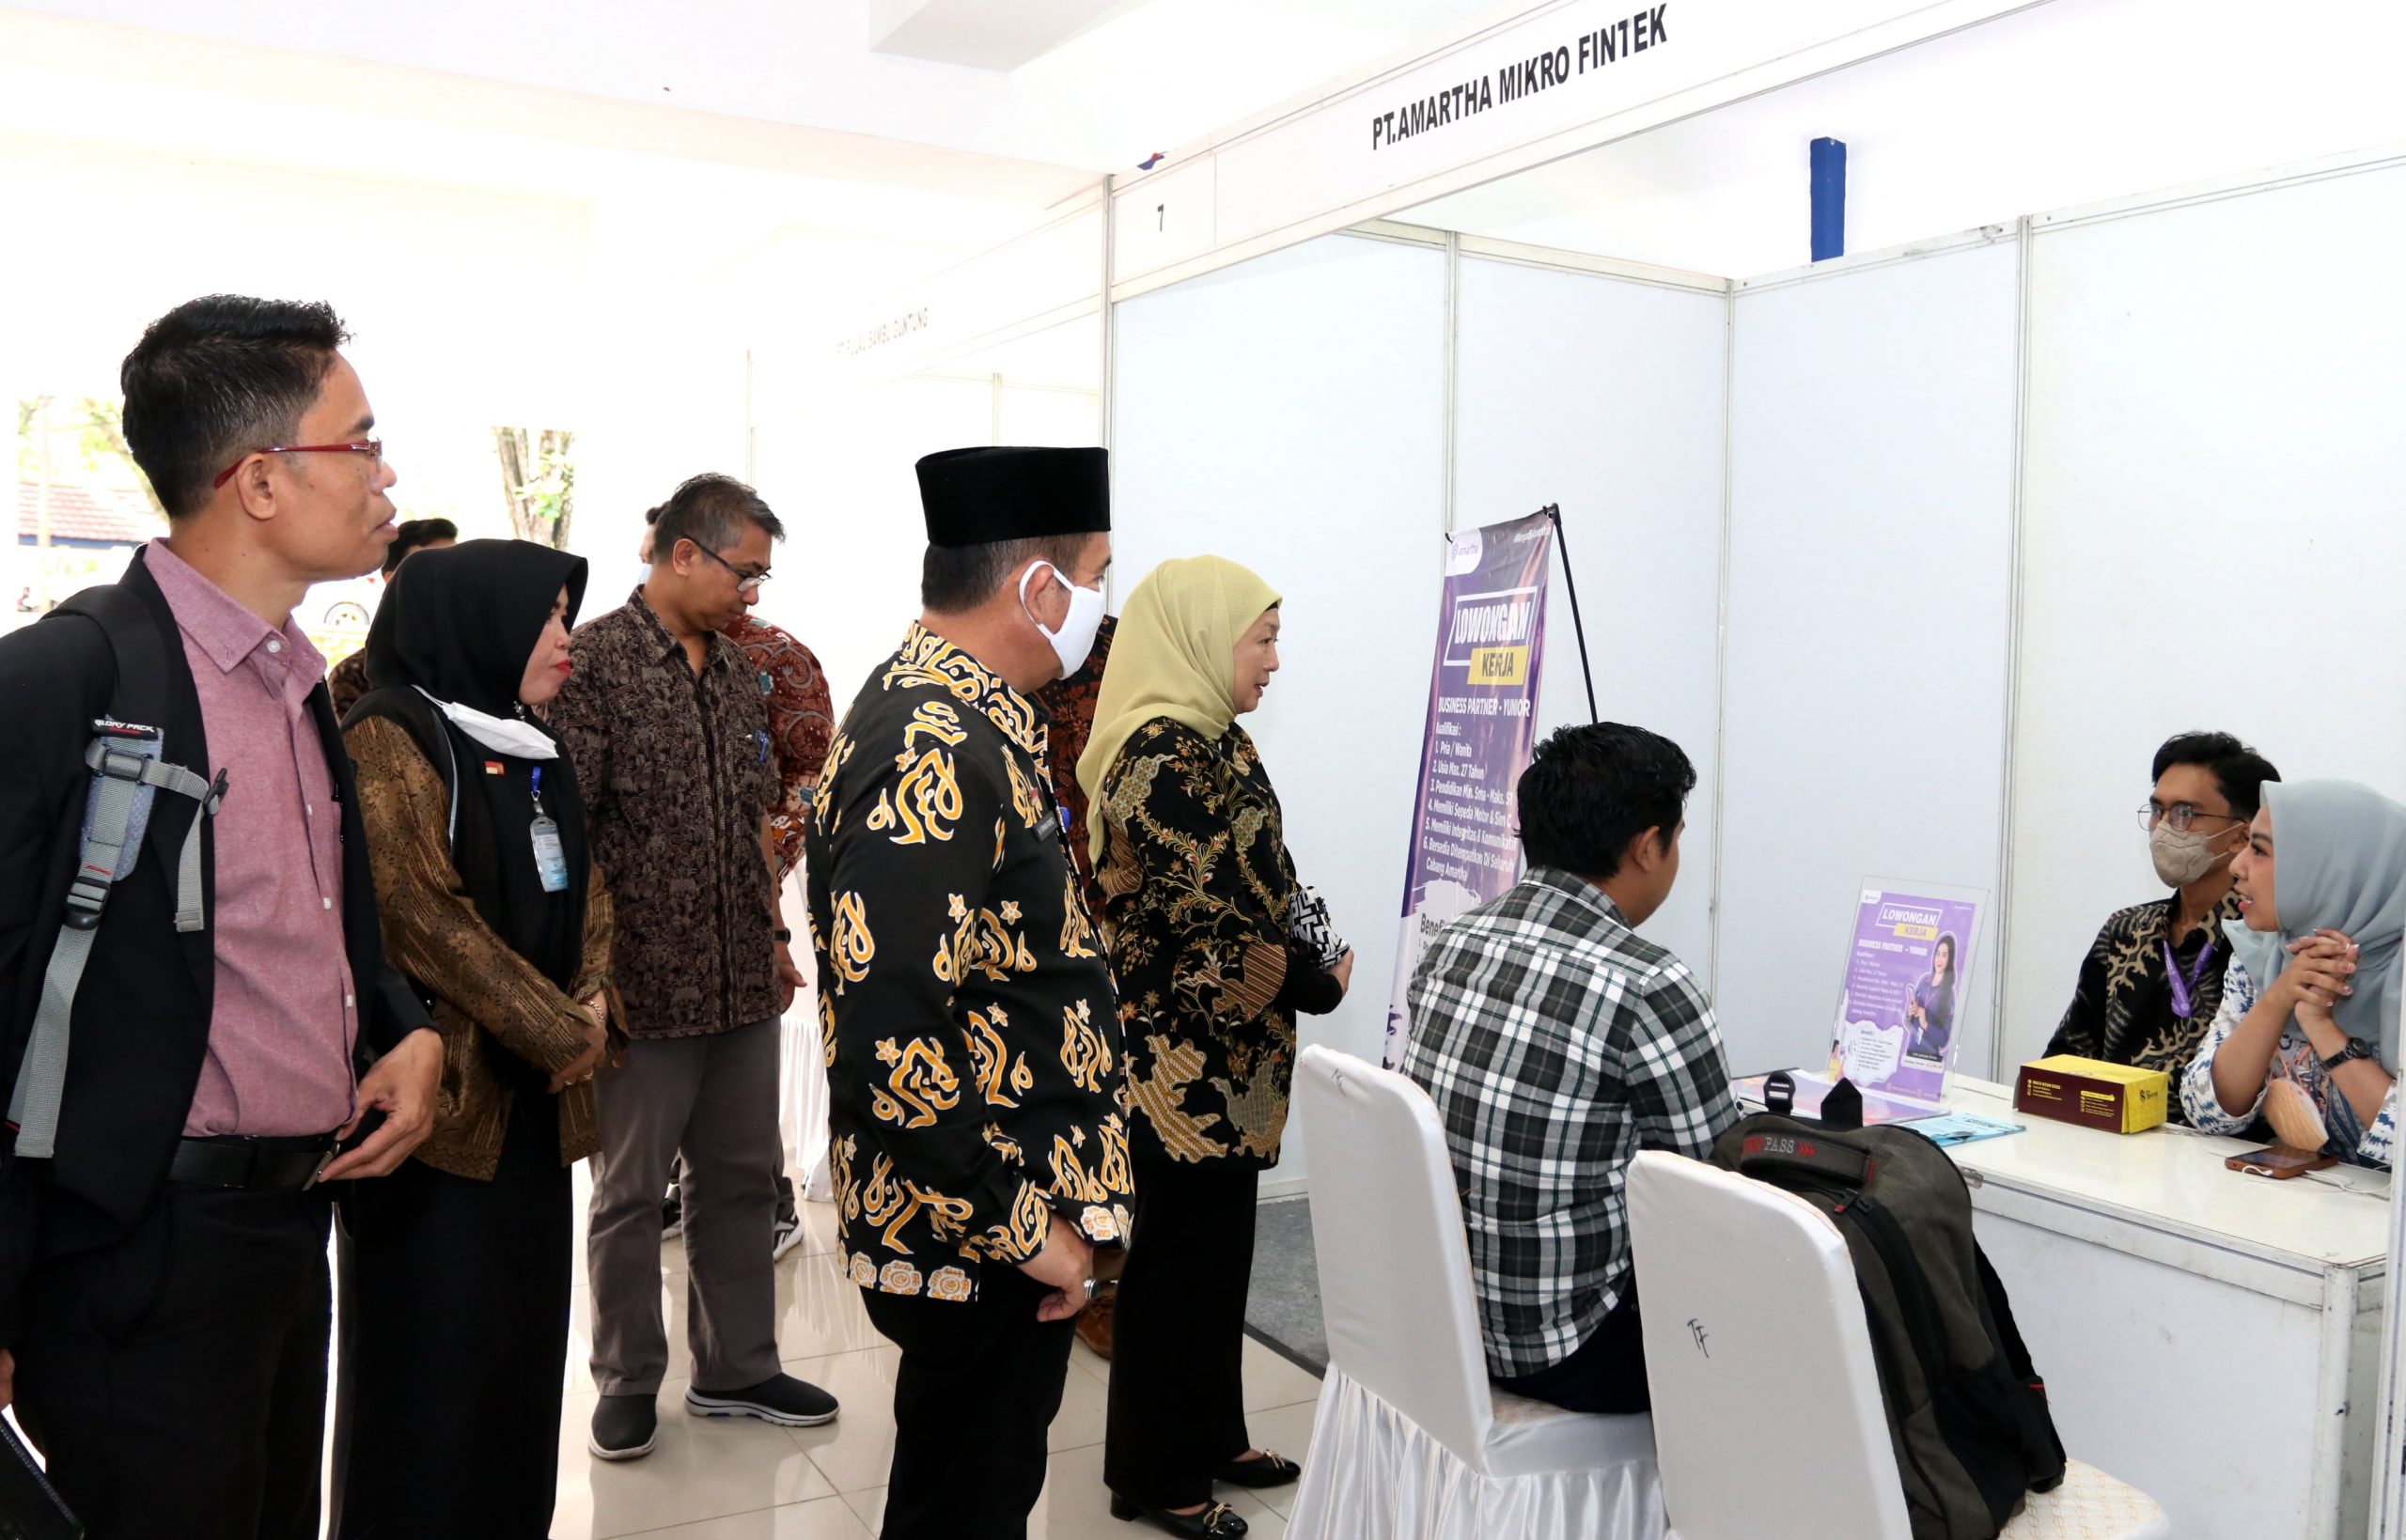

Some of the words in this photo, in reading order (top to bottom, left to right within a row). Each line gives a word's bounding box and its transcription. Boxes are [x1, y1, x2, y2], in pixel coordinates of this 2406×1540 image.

[1374, 76, 1492, 149] PT.AMARTHA
[1500, 46, 1569, 103] MIKRO
[1579, 4, 1666, 74] FINTEK
[1157, 204, 1164, 232] 7
[1455, 601, 1530, 645] LOWONGAN
[1482, 651, 1514, 677] KERJA
[1438, 696, 1466, 714] BUSINESS
[1467, 698, 1498, 716] PARTNER
[1504, 698, 1530, 717] YUNIOR
[126, 723, 155, 733] PACK
[1441, 740, 1450, 754] Pria
[1455, 742, 1472, 757] Wanita
[1432, 759, 1437, 772] 2.
[1438, 761, 1448, 774] Usia
[1449, 762, 1460, 776] Max.
[1461, 763, 1468, 777] 27
[1469, 764, 1484, 780] Tahun
[1430, 779, 1435, 792] 3.
[1436, 780, 1462, 798] Pendidikan
[1463, 784, 1474, 799] Min.
[1475, 786, 1486, 801] Sma
[1428, 798, 1433, 811] 4.
[1432, 800, 1454, 816] Memiliki
[1455, 803, 1473, 821] Sepeda
[1474, 807, 1489, 823] Motor
[1426, 817, 1430, 831] 5.
[1430, 818, 1452, 834] Memiliki
[1452, 823, 1476, 842] Integritas
[1481, 829, 1517, 851] Komunikatif
[1423, 836, 1429, 849] 6.
[1429, 837, 1449, 855] Bersedia
[1450, 843, 1482, 864] Ditempatkan
[1483, 849, 1490, 865] Di
[1491, 853, 1514, 874] Seluruh
[1426, 856, 1445, 877] Cabang
[1445, 862, 1468, 881] Amartha
[1883, 908, 1937, 926] LOWONGAN
[1904, 926, 1928, 937] KERJA
[1763, 1136, 1795, 1155] PASS
